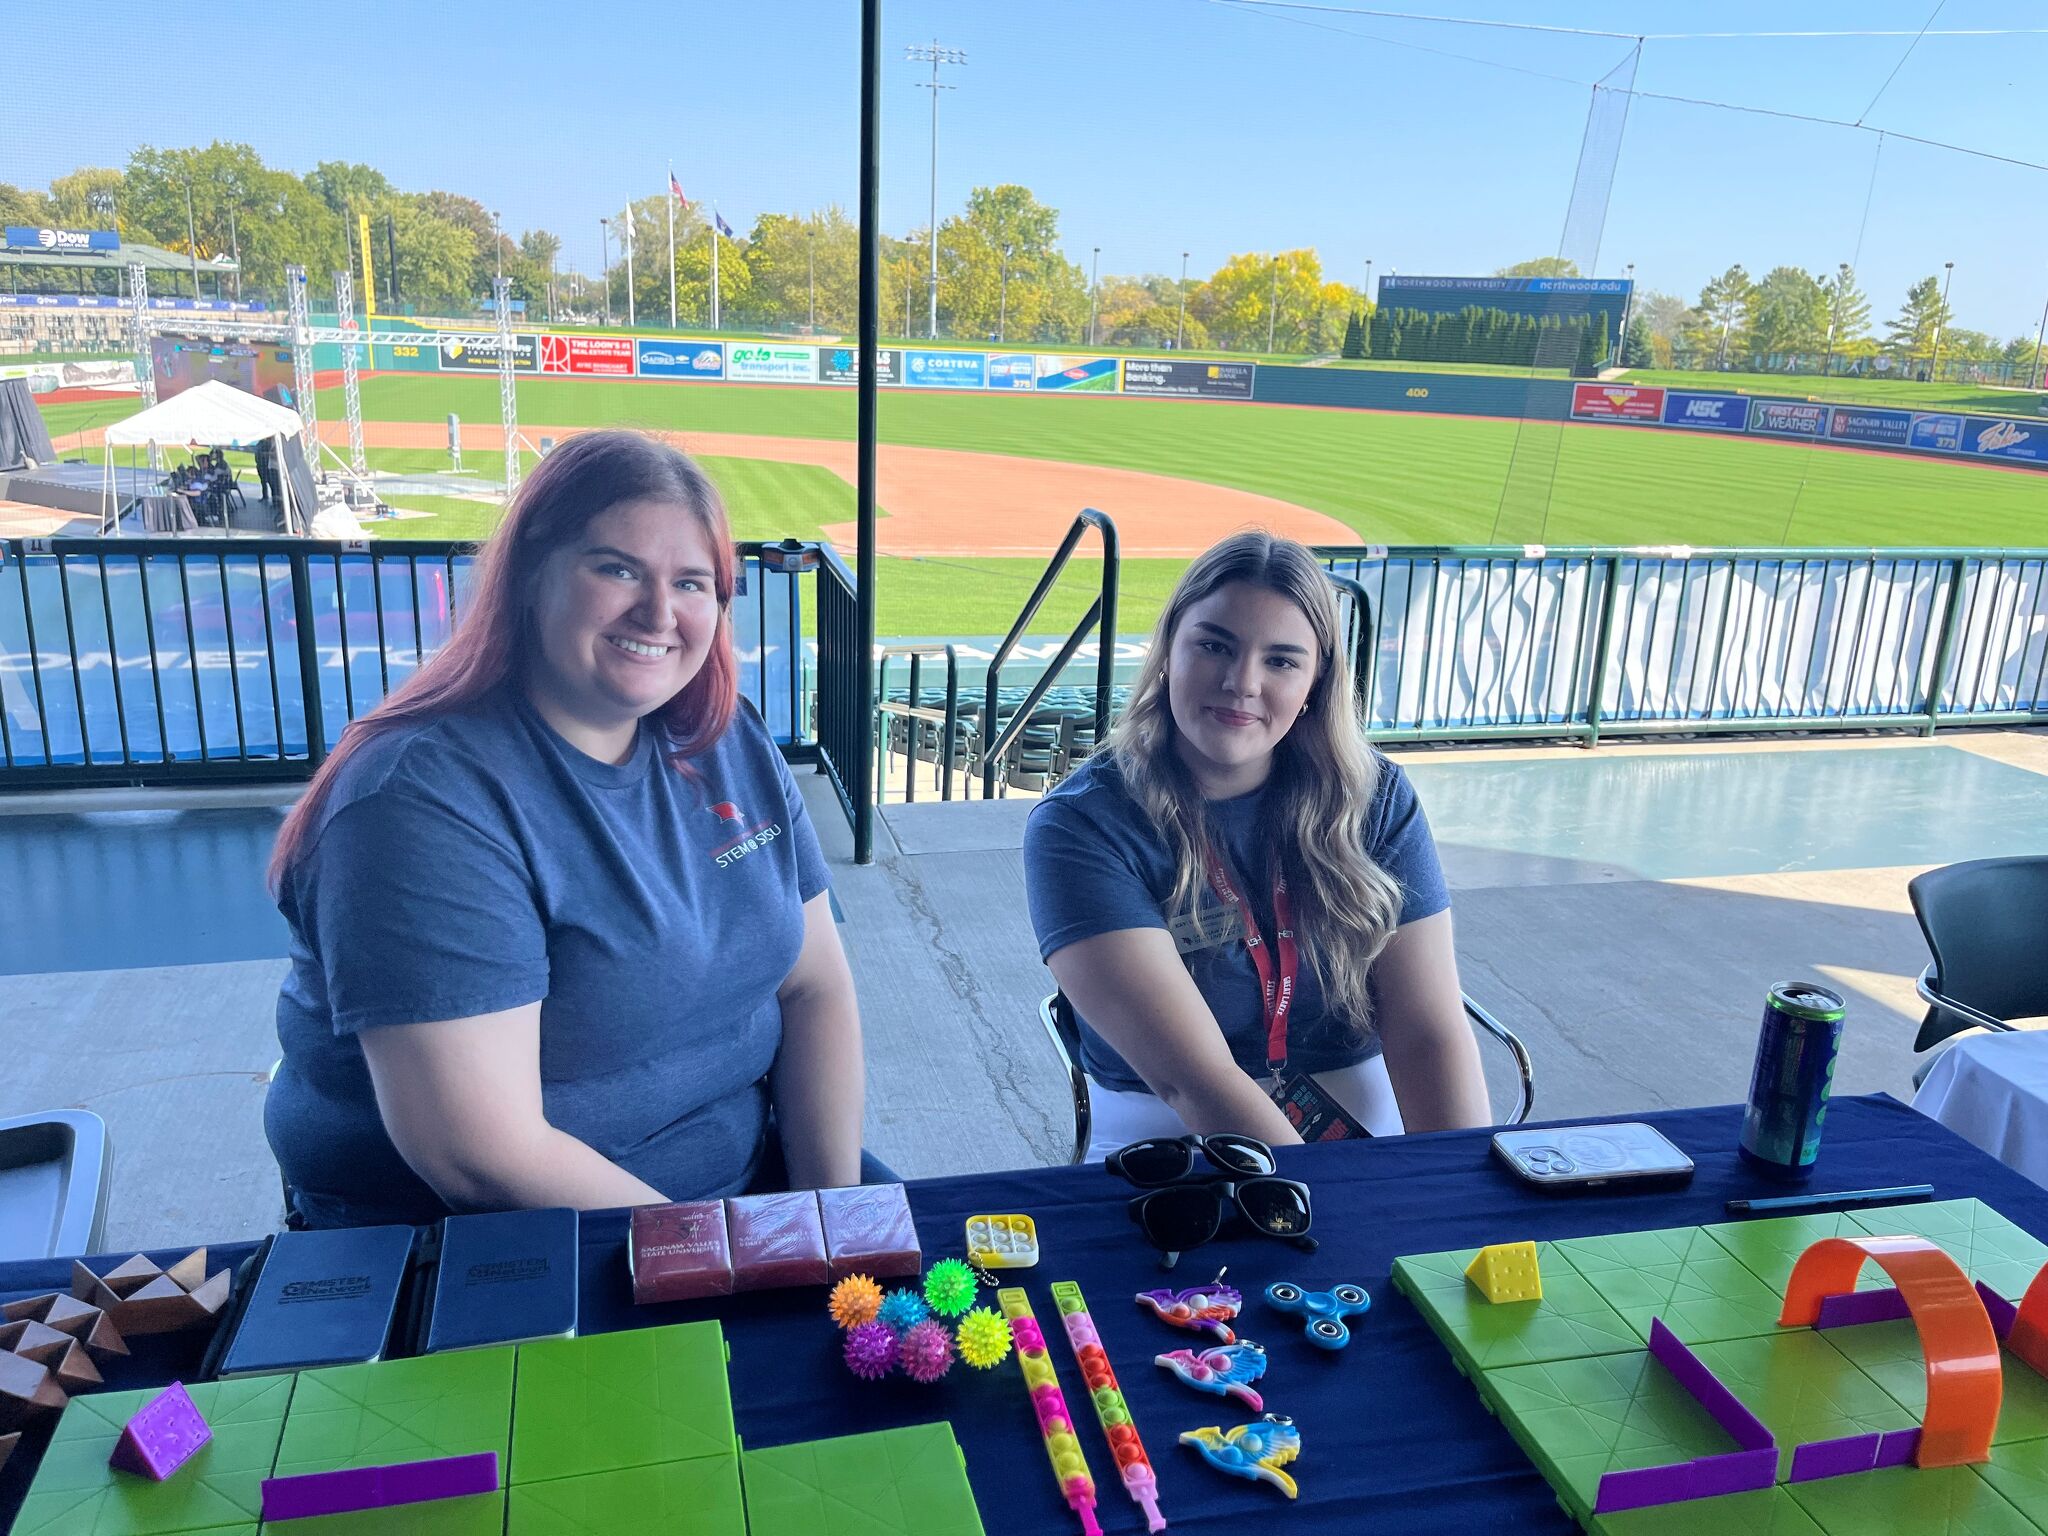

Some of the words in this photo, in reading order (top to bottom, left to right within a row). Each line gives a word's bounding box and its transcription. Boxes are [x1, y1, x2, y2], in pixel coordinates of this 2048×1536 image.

[1396, 279, 1454, 289] NORTHWOOD
[1457, 280, 1507, 290] UNIVERSITY
[1540, 281, 1621, 292] northwood.edu
[393, 346, 419, 357] 332
[741, 361, 789, 373] transport
[928, 359, 978, 369] CORTEVA
[1126, 362, 1150, 372] More
[1150, 362, 1173, 373] than
[1125, 372, 1166, 385] Banking.
[1406, 388, 1429, 398] 400
[1769, 405, 1793, 416] FIRST
[1793, 407, 1820, 419] ALERT
[1769, 416, 1816, 431] WEATHER
[1847, 416, 1880, 428] SAGINAW
[1882, 419, 1908, 430] VALLEY
[641, 1242, 686, 1253] SAGINAW
[687, 1239, 720, 1248] VALLEY
[641, 1249, 666, 1258] STATE
[668, 1245, 721, 1256] UNIVERSITY
